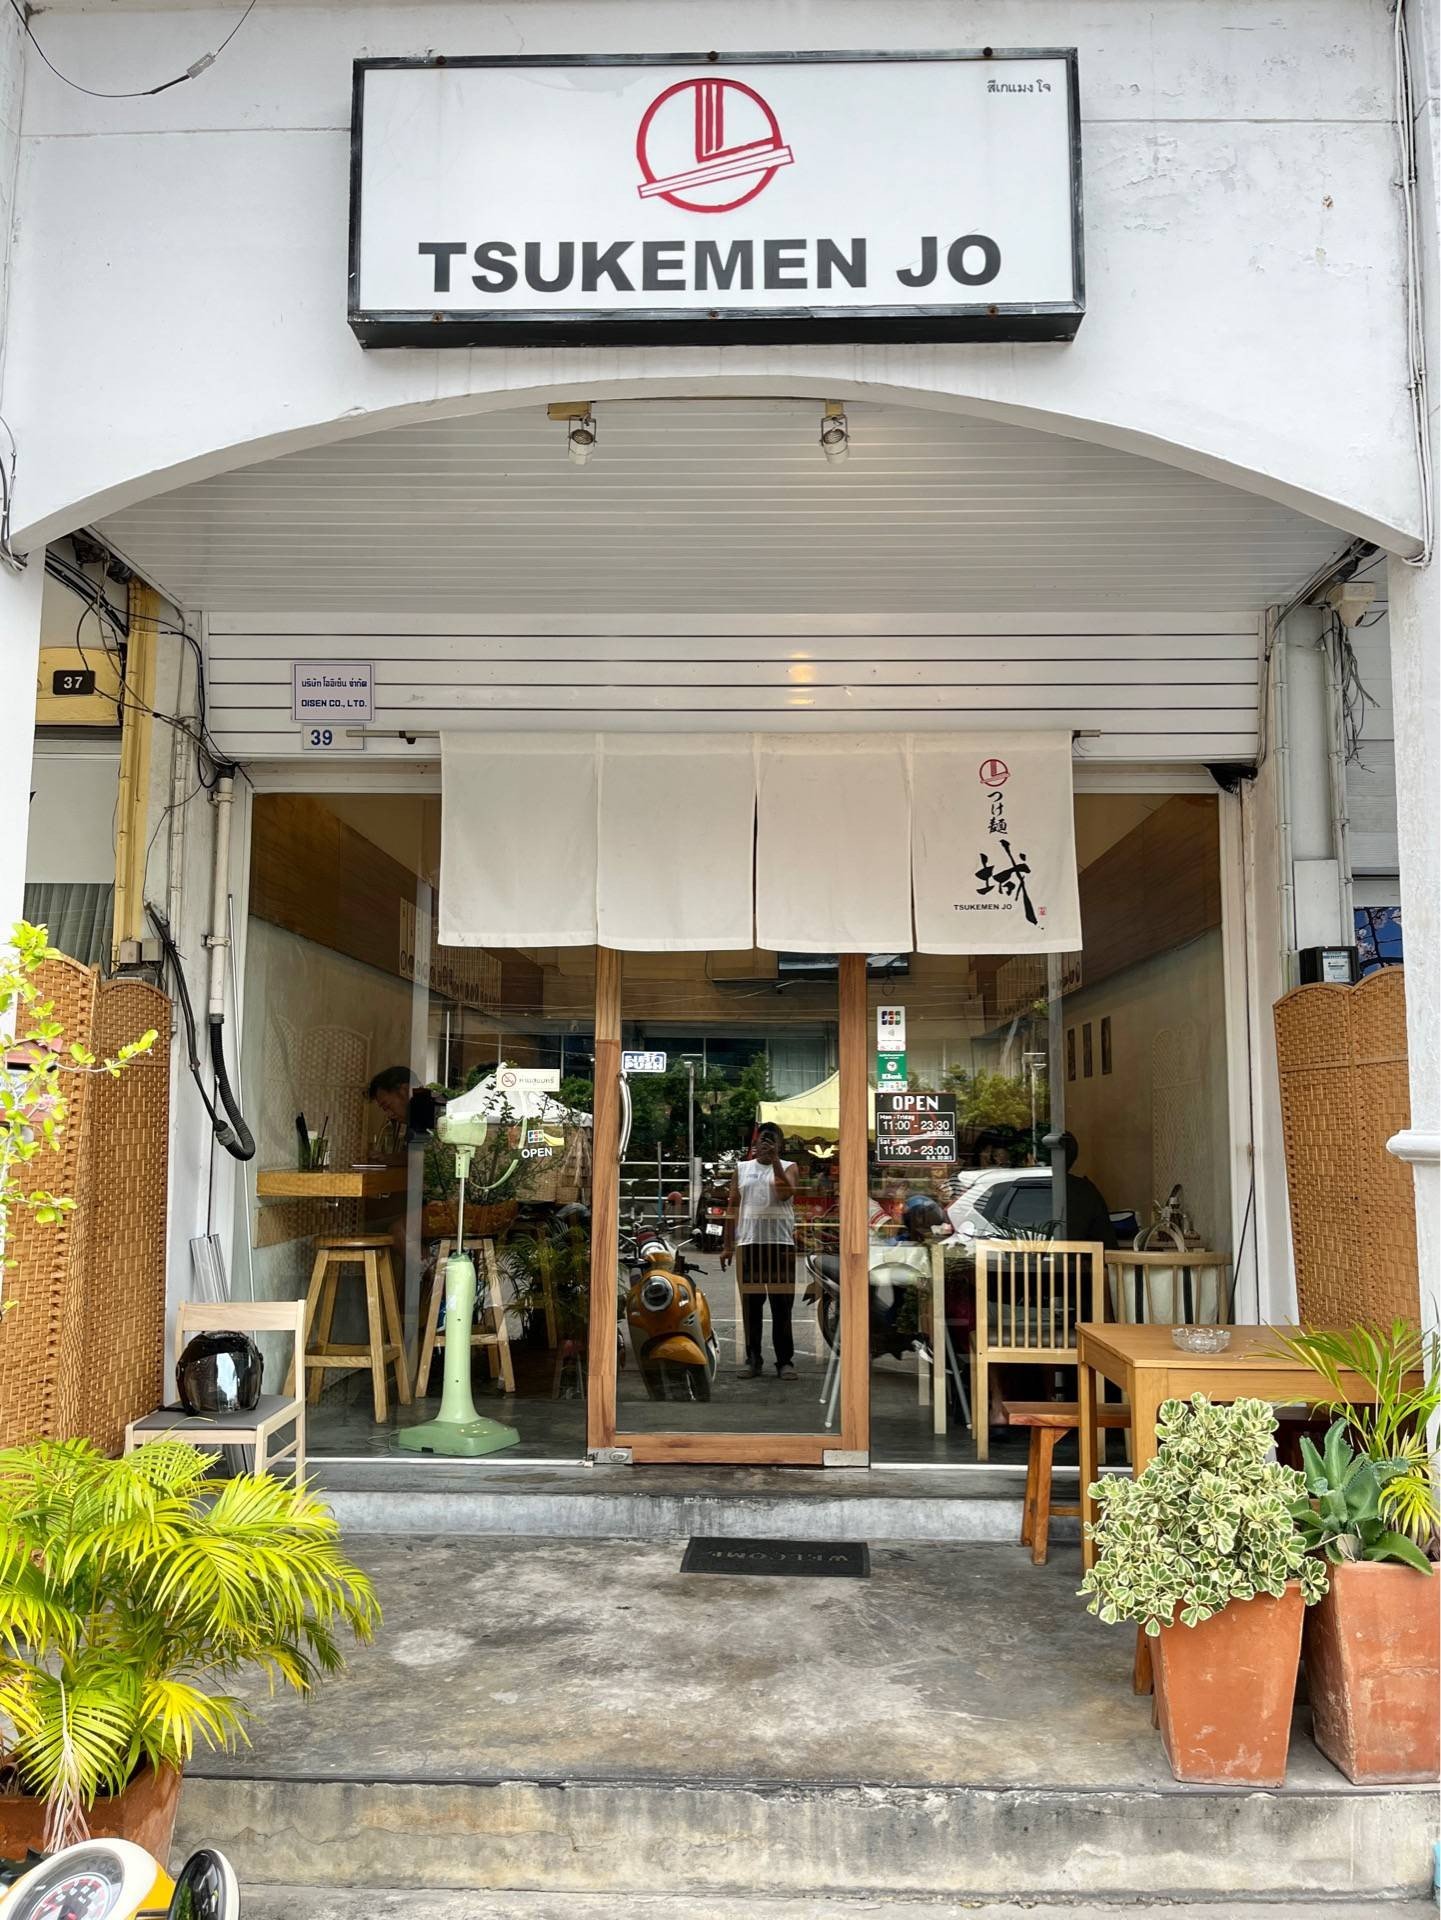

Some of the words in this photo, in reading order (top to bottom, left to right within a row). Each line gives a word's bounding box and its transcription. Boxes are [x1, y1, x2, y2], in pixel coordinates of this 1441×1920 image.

[418, 238, 868, 293] TSUKEMEN
[896, 234, 1002, 288] JO
[63, 676, 83, 689] 37
[347, 699, 368, 708] LTD.
[310, 729, 333, 746] 39
[974, 838, 1040, 927] 城
[953, 903, 1000, 911] TSUKEMEN
[892, 1095, 939, 1111] OPEN
[883, 1120, 910, 1130] 11:00
[920, 1120, 949, 1130] 23:30
[521, 1147, 552, 1158] OPEN
[884, 1145, 911, 1155] 11:00
[920, 1145, 950, 1155] 23:00
